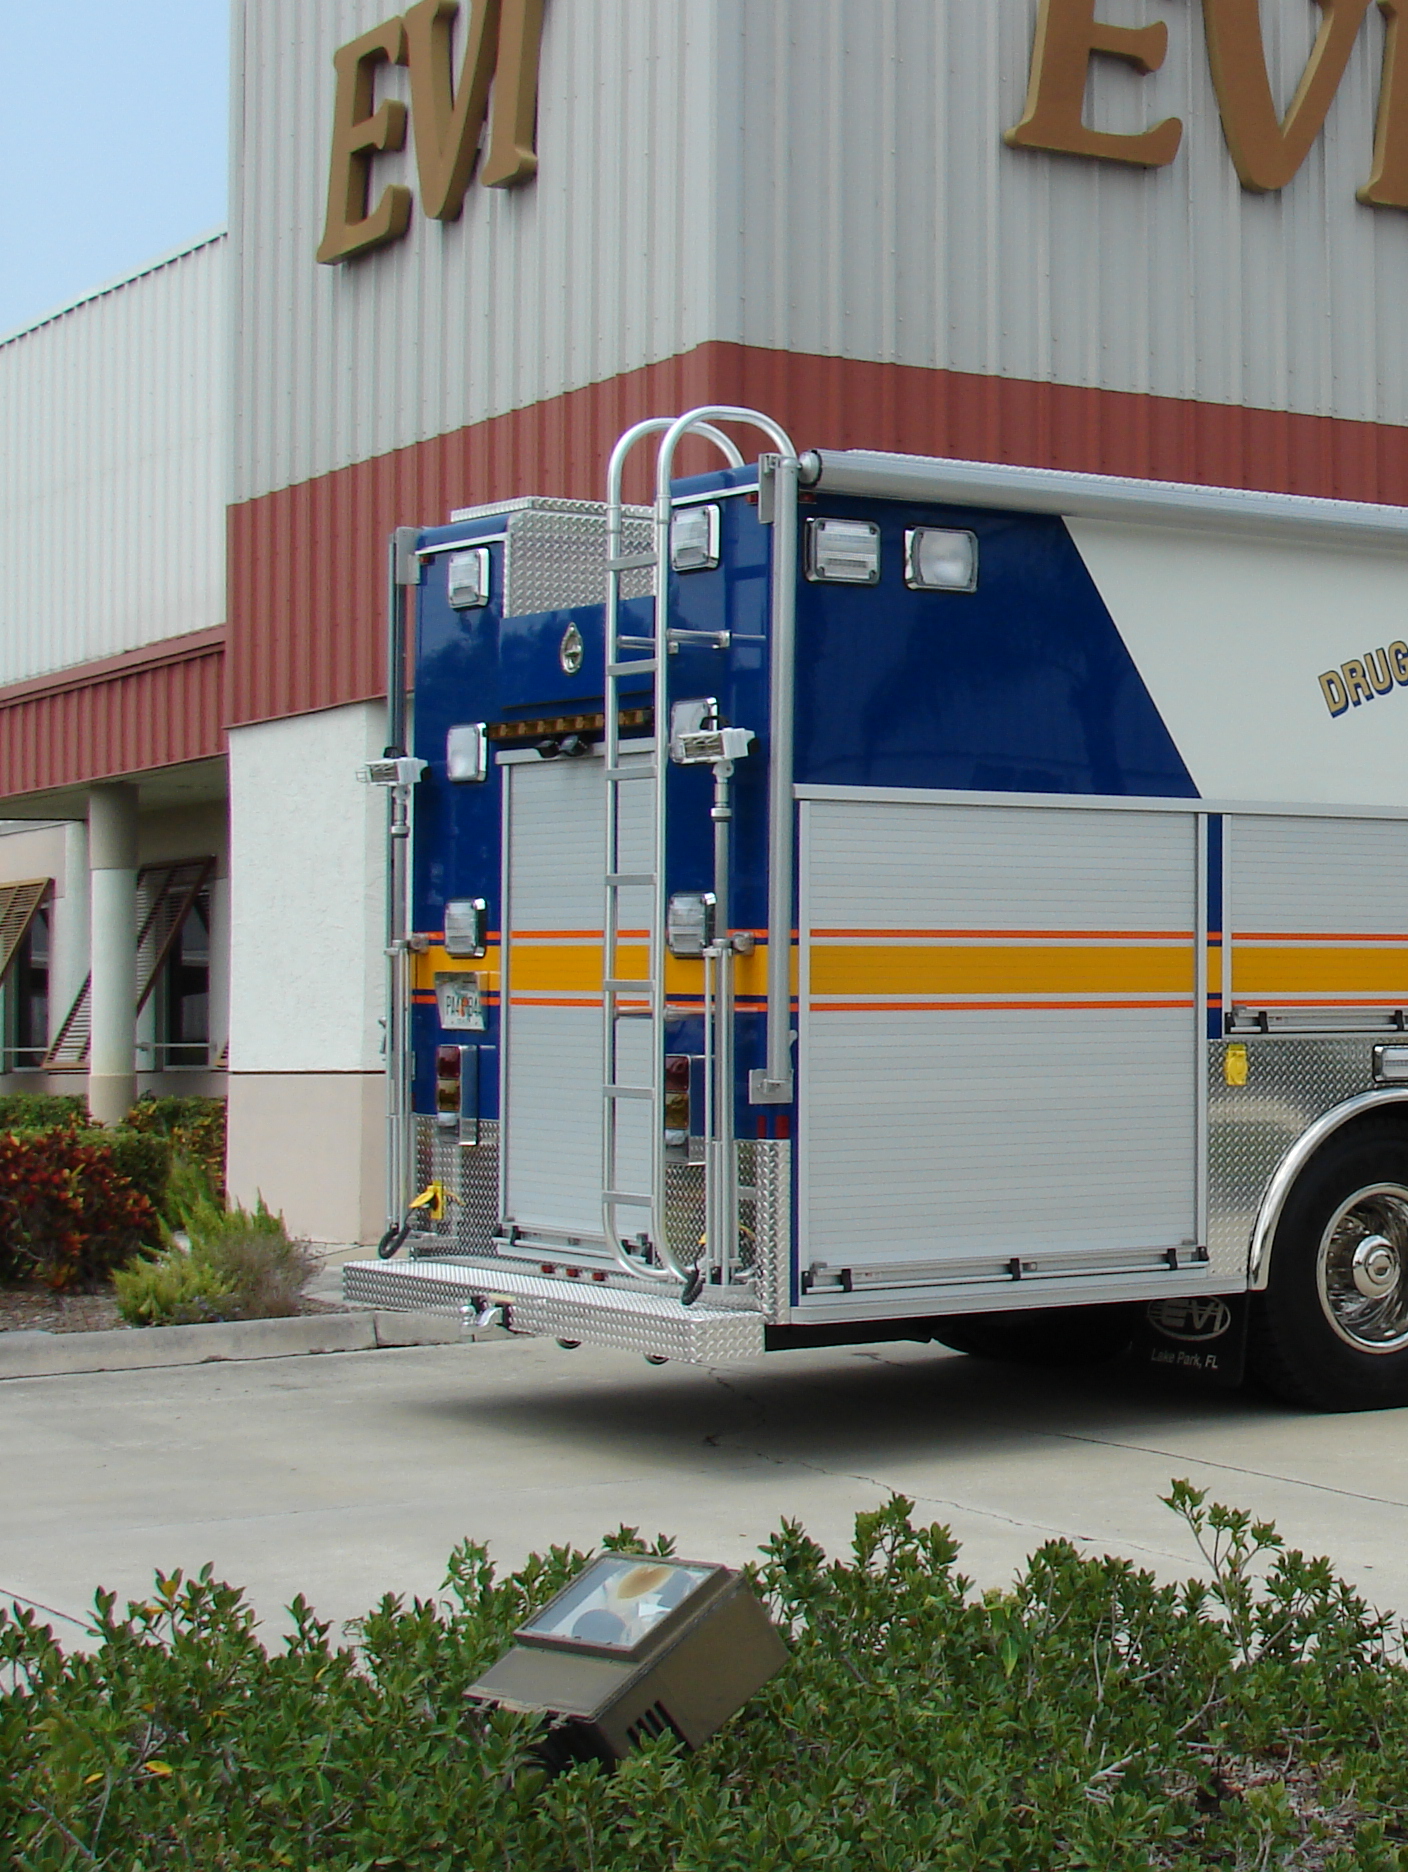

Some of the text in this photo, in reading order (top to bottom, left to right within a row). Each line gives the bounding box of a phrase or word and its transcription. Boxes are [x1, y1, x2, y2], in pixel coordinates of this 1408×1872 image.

[316, 0, 545, 266] EVI
[1150, 1348, 1219, 1370] Lake Park, FL
